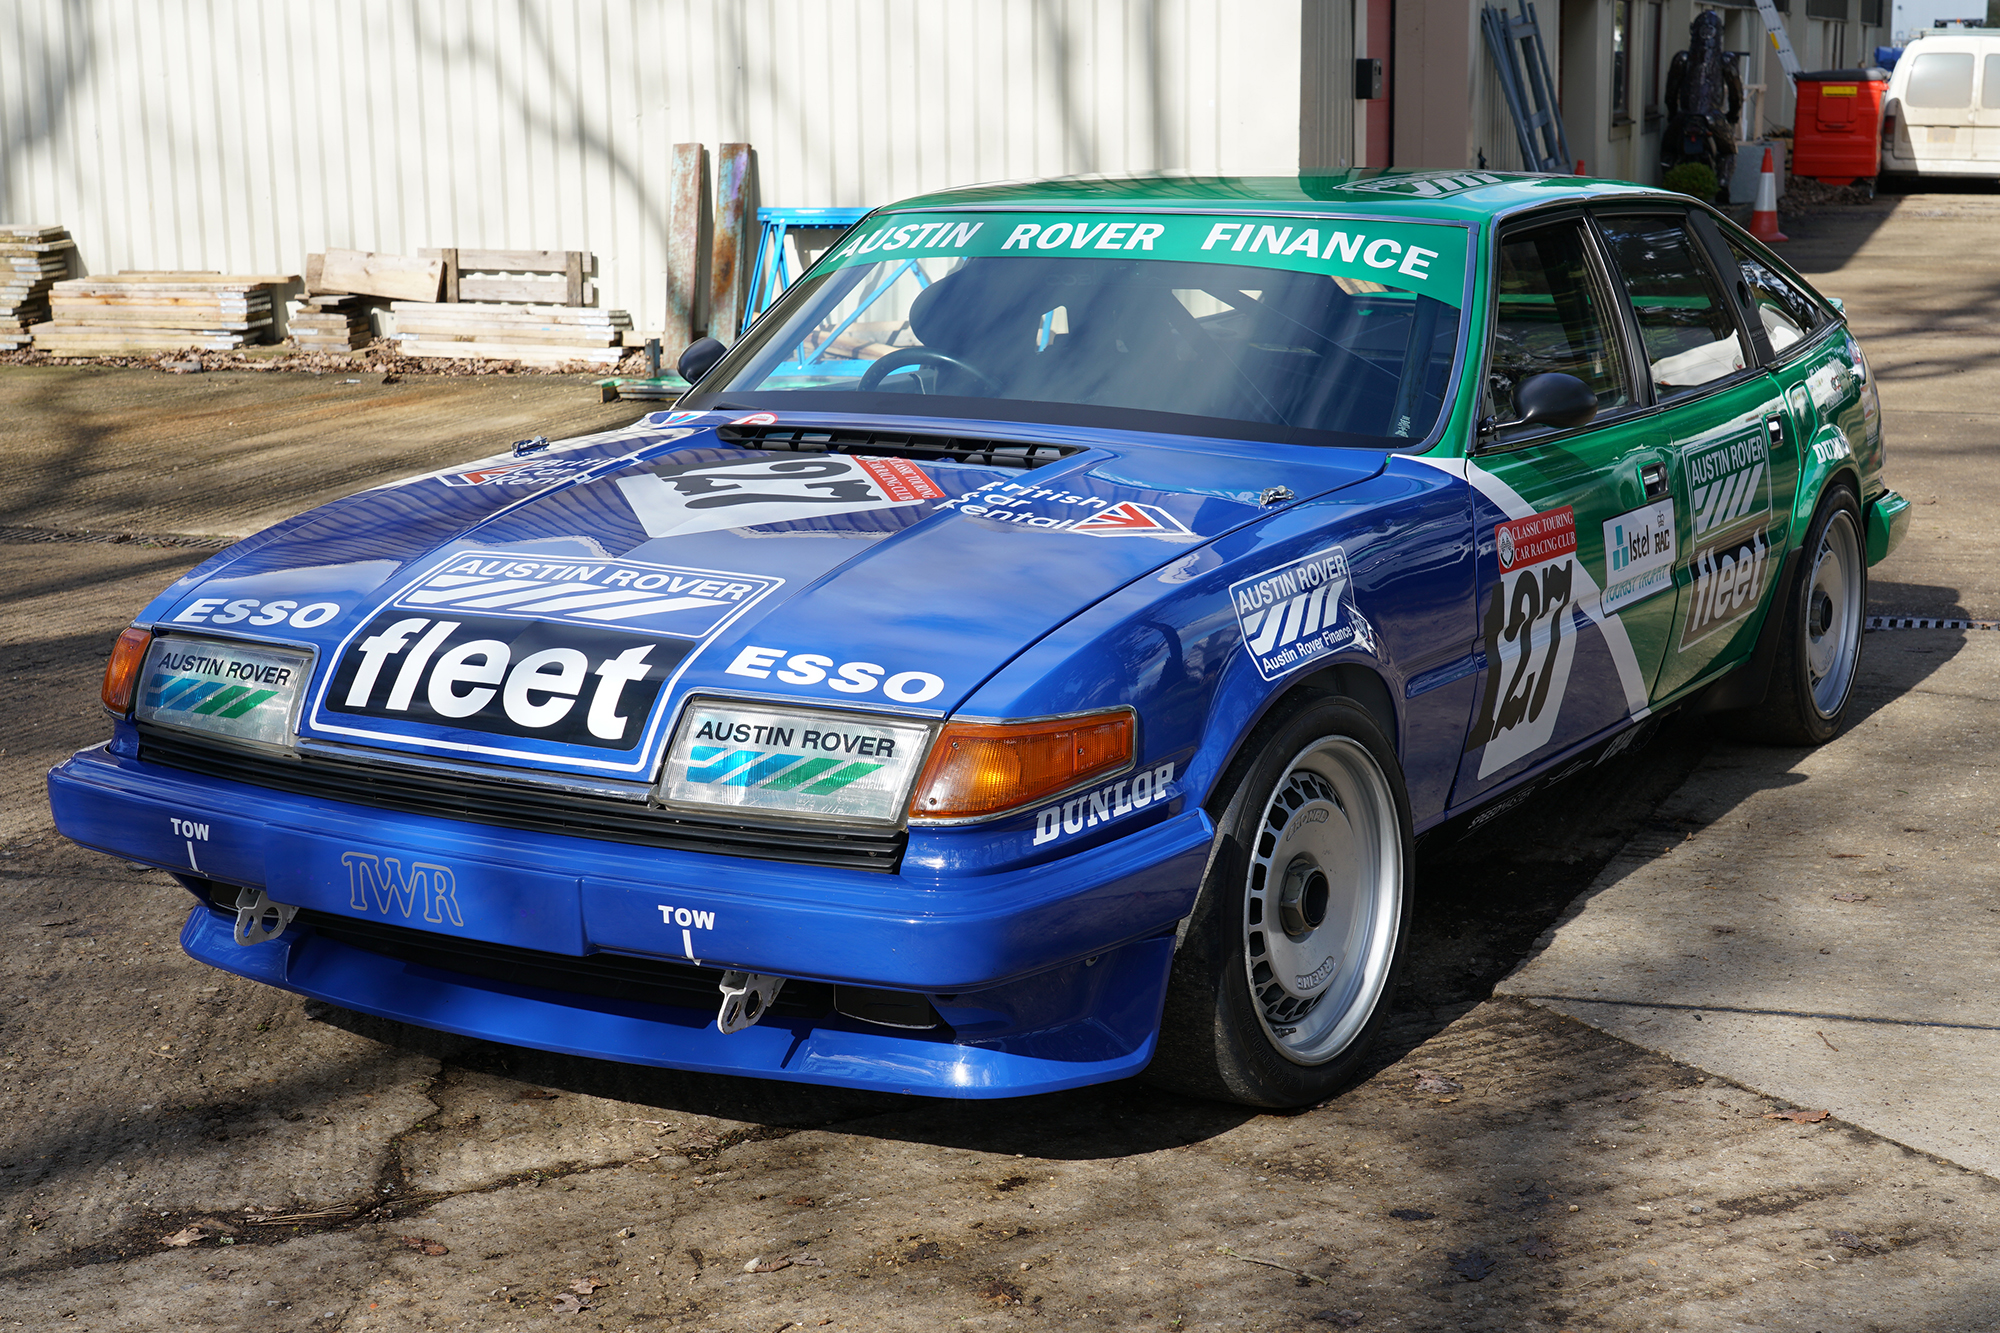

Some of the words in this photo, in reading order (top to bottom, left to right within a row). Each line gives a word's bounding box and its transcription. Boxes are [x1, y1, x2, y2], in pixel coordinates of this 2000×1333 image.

[830, 222, 984, 262] AUSTIN
[1001, 222, 1164, 250] ROVER
[1202, 223, 1438, 280] FINANCE
[1691, 450, 1731, 487] AUSTIN
[1731, 435, 1765, 471] ROVER
[874, 468, 903, 487] RACING
[891, 486, 914, 500] CLUB
[905, 475, 937, 498] TOURING
[1512, 521, 1541, 541] CLASSIC
[1542, 511, 1573, 532] TOURING
[1515, 545, 1530, 562] CAR
[1531, 537, 1557, 556] RACING
[1558, 531, 1576, 548] CLUB
[1629, 525, 1650, 561] Istel
[1654, 529, 1670, 555] RAC
[447, 559, 606, 582] AUSTIN
[601, 567, 753, 600] ROVER
[1238, 572, 1297, 614] AUSTIN
[1296, 554, 1347, 590] ROVER
[1691, 526, 1766, 632] fleet
[172, 598, 340, 628] ESSO
[158, 652, 224, 675] AUSTIN
[226, 661, 291, 686] ROVER
[1262, 648, 1298, 673] Austin
[1296, 636, 1324, 657] Rover
[1323, 626, 1352, 646] Finance
[1464, 559, 1572, 753] 127
[345, 617, 656, 739] fleet
[725, 645, 945, 703] ESSO
[696, 721, 794, 746] AUSTIN
[801, 730, 896, 757] ROVER
[1033, 762, 1174, 846] DUNLOP
[170, 817, 209, 841] TOW
[341, 851, 464, 927] TWR
[658, 904, 715, 930] TOW
